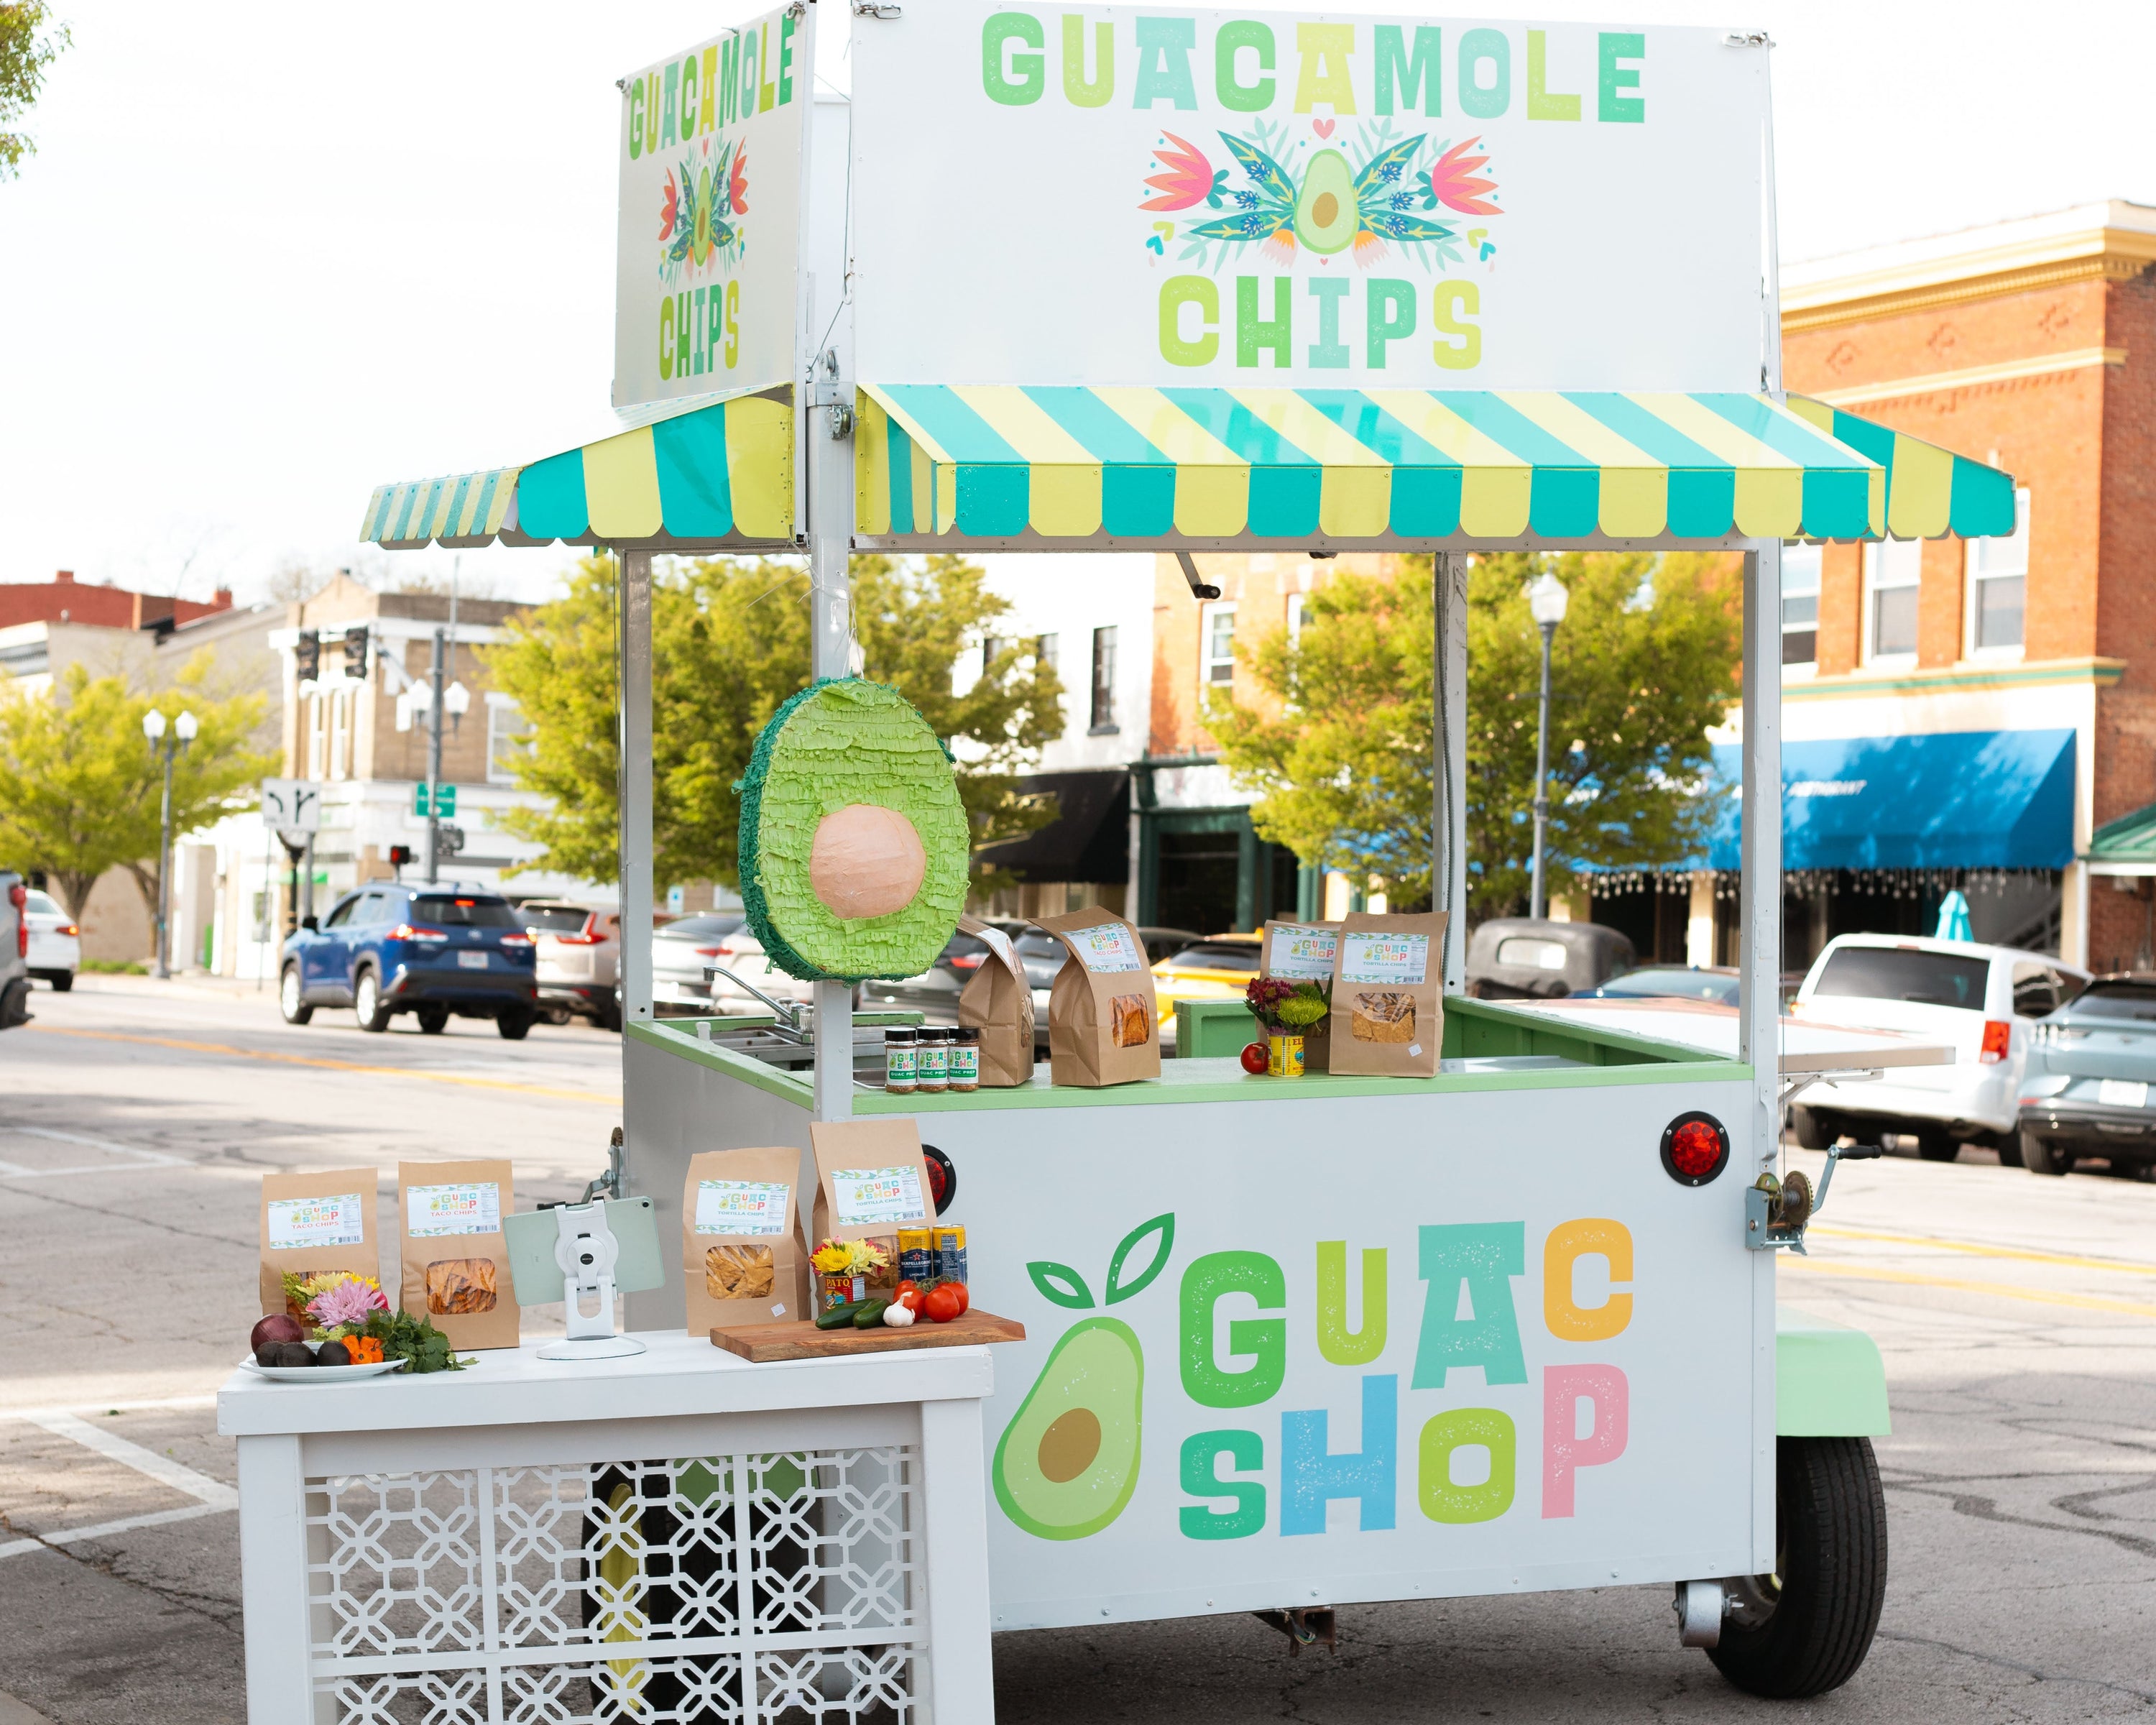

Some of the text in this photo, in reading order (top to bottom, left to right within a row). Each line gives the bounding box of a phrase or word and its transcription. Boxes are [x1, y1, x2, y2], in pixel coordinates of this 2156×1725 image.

[982, 12, 1646, 124] GUACAMOLE
[629, 12, 796, 160] GUACAMOLE
[1158, 275, 1483, 371] CHIPS
[659, 280, 740, 382] CHIPS
[1093, 932, 1118, 943] GUAC
[1097, 940, 1120, 950] SHOP
[1302, 939, 1335, 949] GUAC
[1374, 944, 1408, 954] GUAC
[1301, 949, 1334, 957] SHOP
[1373, 952, 1407, 961] SHOP
[954, 1051, 977, 1060] GUAC
[926, 1059, 946, 1068] SHOP
[954, 1058, 977, 1067] SHOP
[864, 1180, 899, 1193] GUAC
[441, 1192, 476, 1204] GUAC
[730, 1193, 766, 1203] GUAC
[865, 1187, 900, 1200] SHOP
[303, 1205, 338, 1215] GUAC
[441, 1200, 476, 1210] SHOP
[729, 1202, 765, 1210] SHOP
[303, 1211, 338, 1223] SHOP
[826, 1278, 850, 1287] PATO
[1179, 1218, 1634, 1409] GUAC
[1179, 1363, 1629, 1541] SHOP
